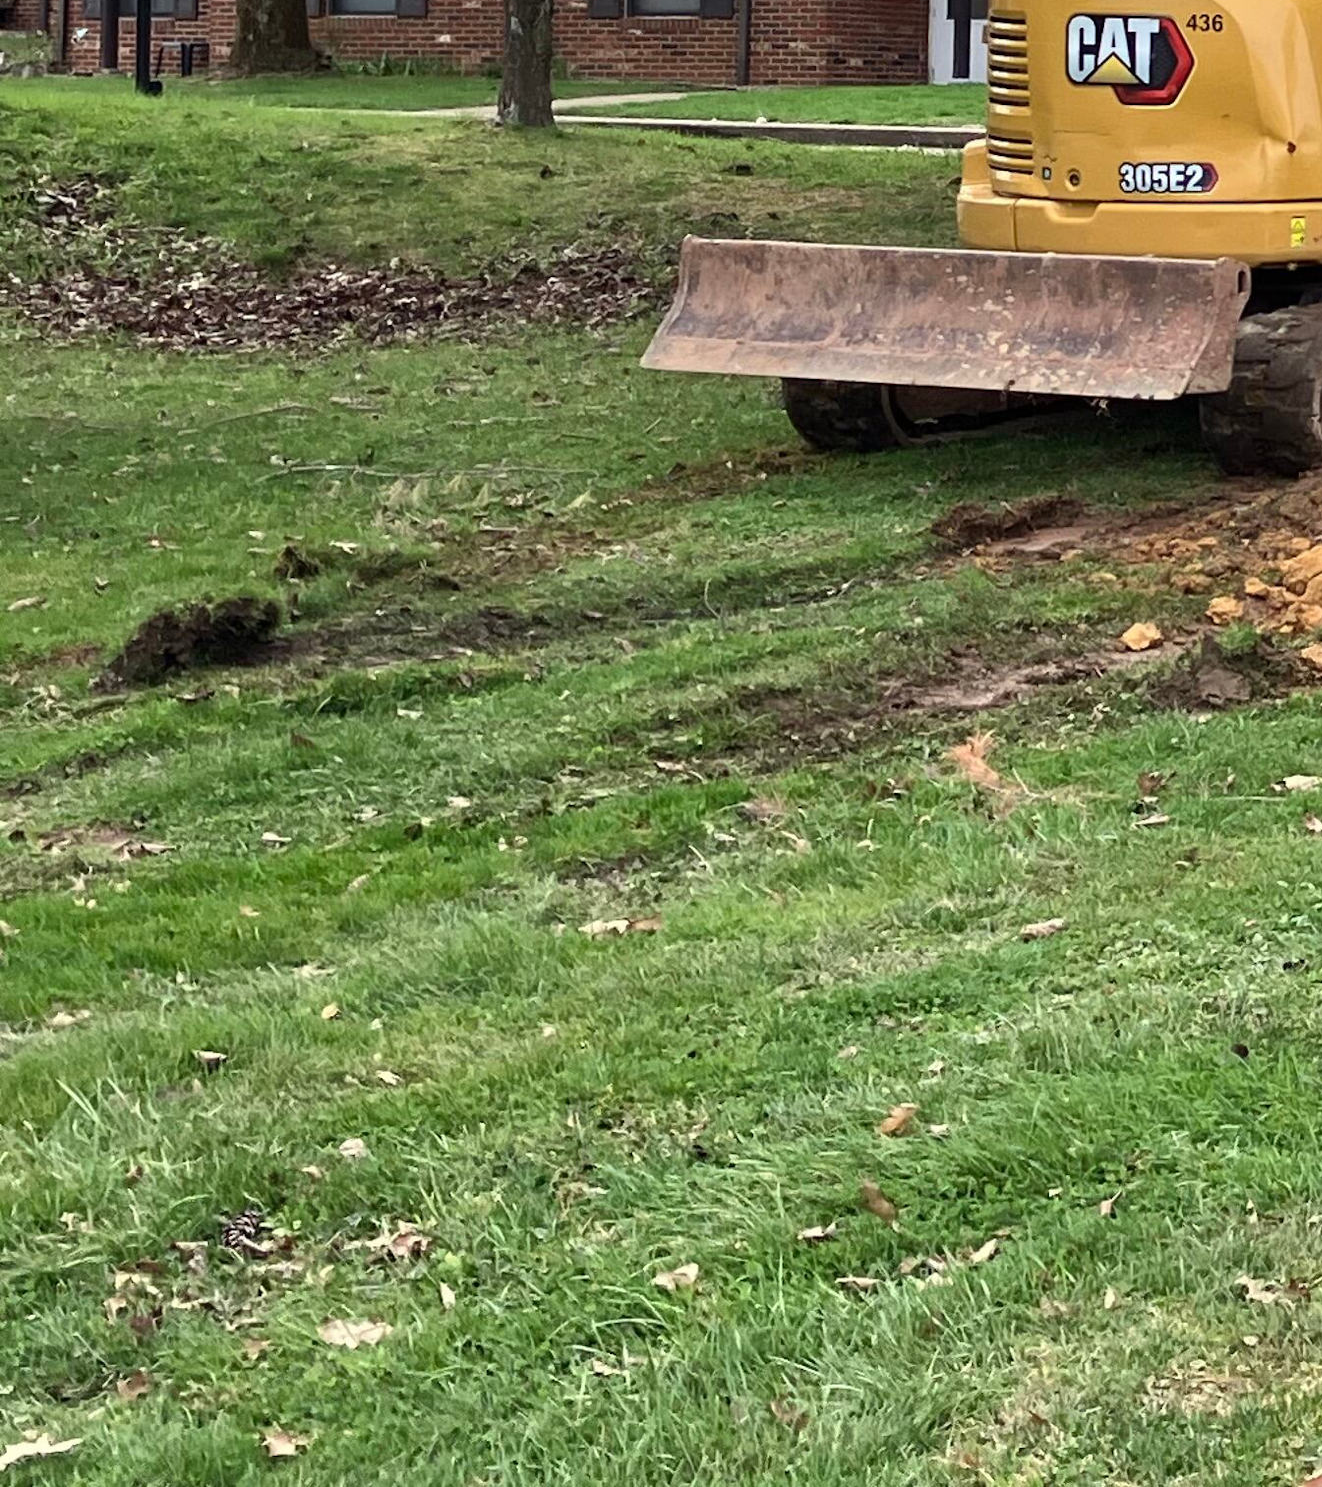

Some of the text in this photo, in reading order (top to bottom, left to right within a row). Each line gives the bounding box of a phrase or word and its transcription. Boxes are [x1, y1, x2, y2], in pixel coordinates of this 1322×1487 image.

[1186, 14, 1224, 32] 436
[1068, 14, 1160, 85] CAT
[1119, 163, 1204, 193] 305E2
